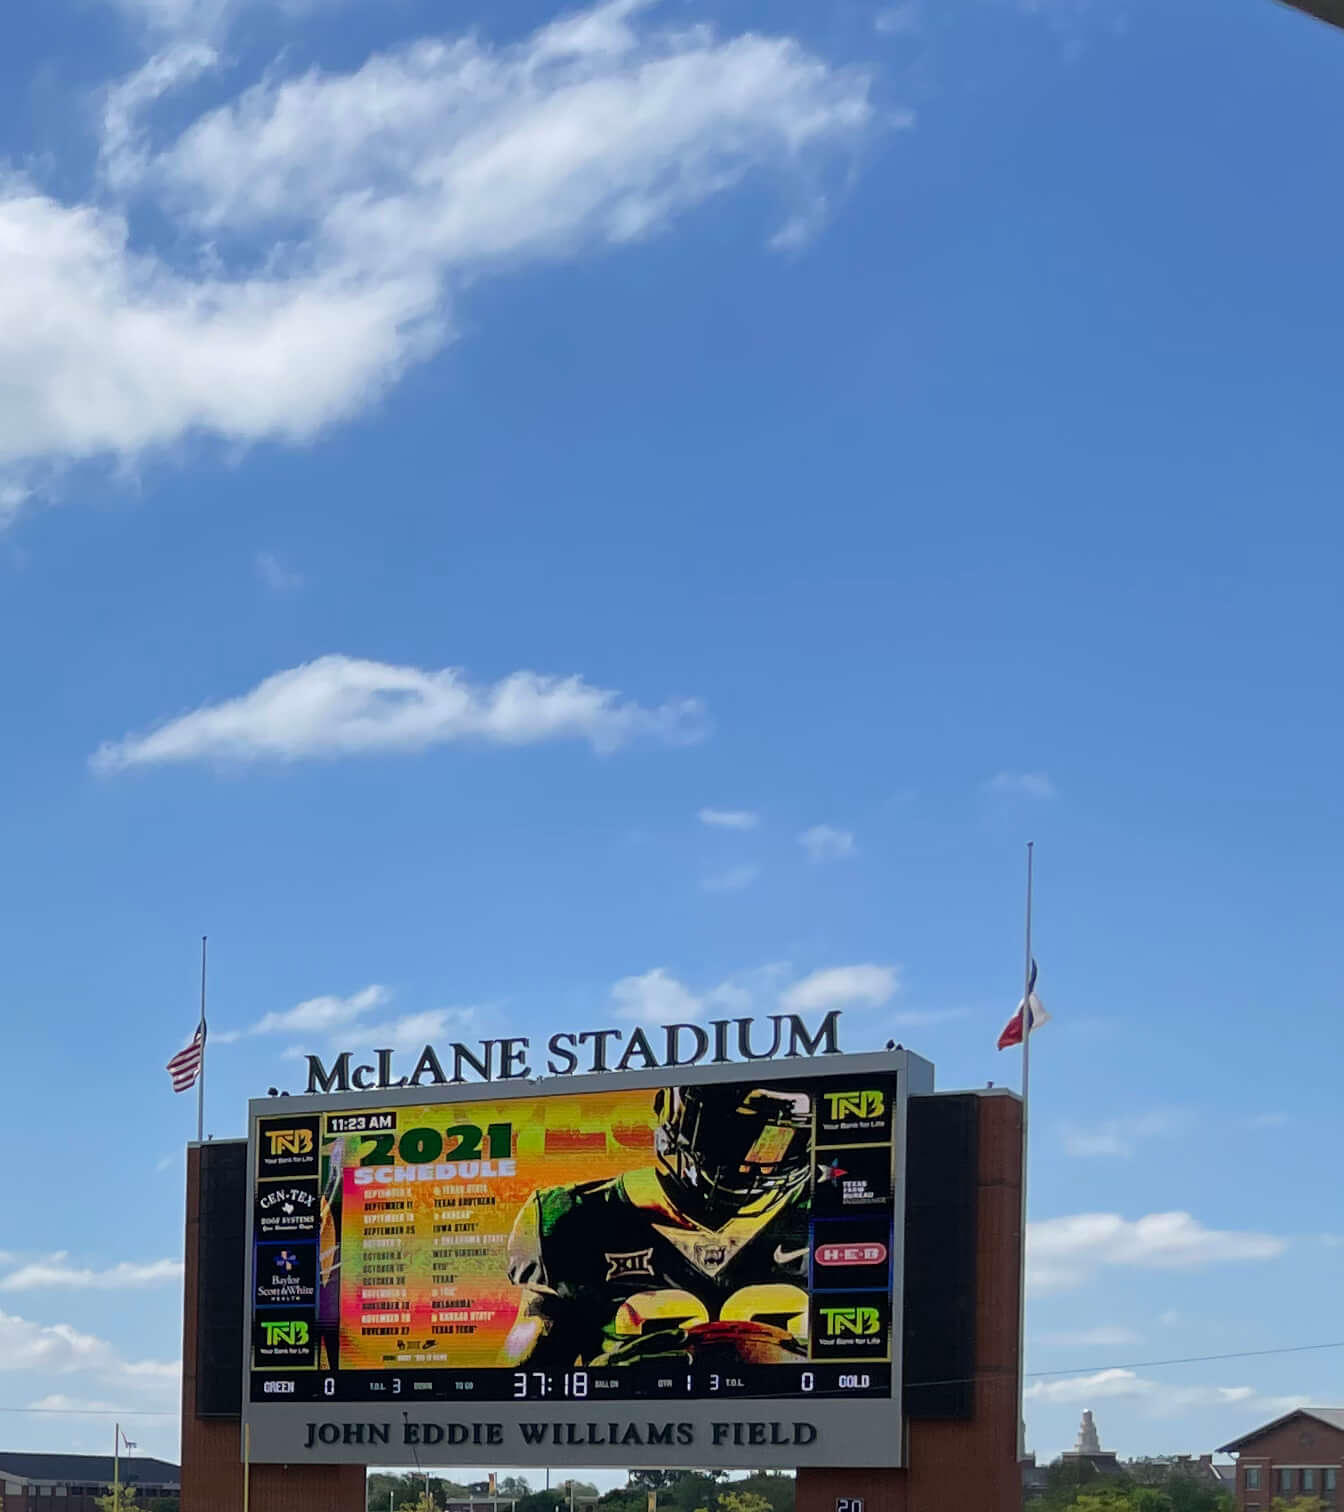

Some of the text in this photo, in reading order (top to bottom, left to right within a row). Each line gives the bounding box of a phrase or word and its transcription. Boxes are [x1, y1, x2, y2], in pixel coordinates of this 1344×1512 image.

[304, 1010, 842, 1095] McLANE STADIUM
[331, 1115, 392, 1132] 11:23 AM
[359, 1122, 512, 1167] 2021
[353, 1159, 517, 1185] SCHEDULE
[263, 1381, 295, 1393] GREEN
[324, 1378, 335, 1395] 0
[392, 1379, 401, 1394] 3
[513, 1372, 588, 1397] 37:18
[709, 1374, 719, 1390] 3
[801, 1372, 813, 1391] 0
[838, 1375, 870, 1388] GOLD
[304, 1421, 818, 1448] JOHN EDDIE WILLIAMS FIELD
